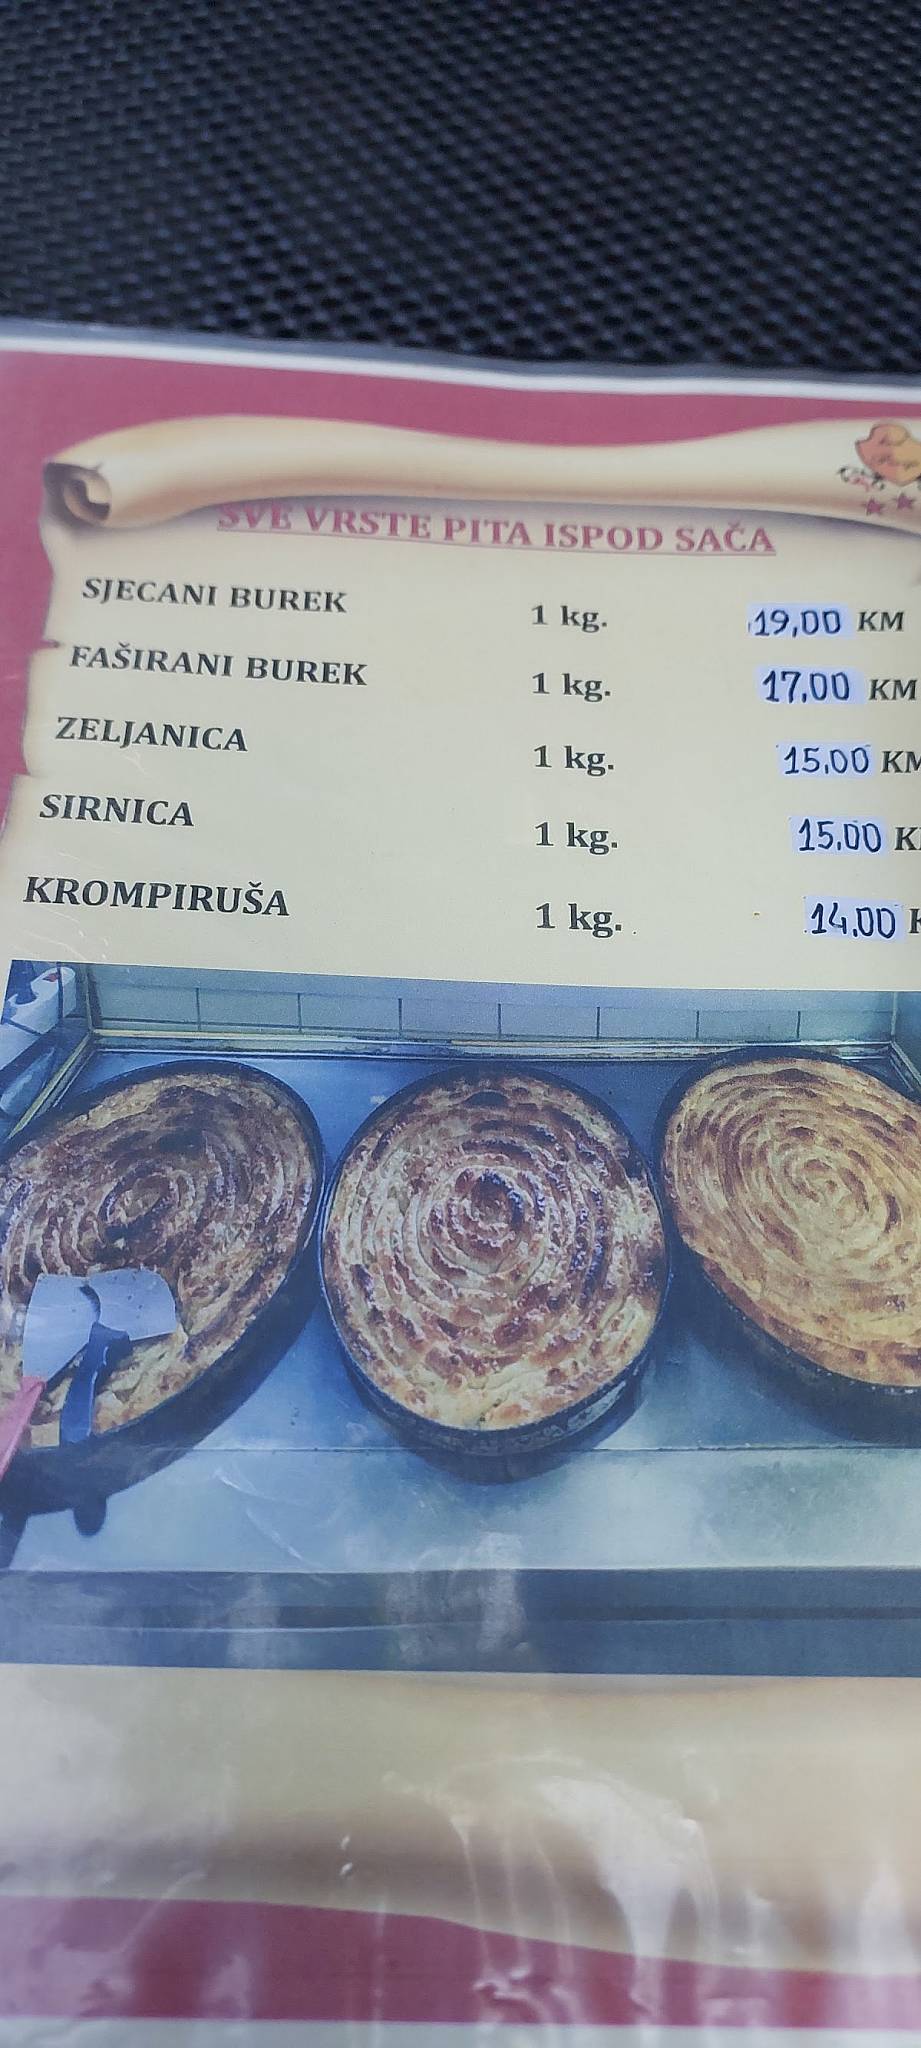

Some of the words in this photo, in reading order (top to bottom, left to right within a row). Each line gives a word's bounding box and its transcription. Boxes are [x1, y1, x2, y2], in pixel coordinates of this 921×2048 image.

[217, 499, 293, 531] SVE
[303, 506, 432, 540] VRSTE
[442, 516, 533, 546] PITA
[543, 520, 664, 551] ISPOD
[674, 519, 777, 553] SAČA
[82, 577, 217, 607] SJECANI
[230, 586, 347, 614] BUREK
[531, 604, 548, 625] 1
[560, 604, 608, 634] kg.
[754, 608, 842, 639] 19,00
[857, 610, 905, 632] KM
[69, 641, 234, 677] FAŠIRANI
[244, 656, 368, 686] BUREK
[532, 671, 551, 695] 1
[561, 672, 611, 703] kg.
[762, 669, 850, 704] 17,00
[868, 678, 918, 702] KM
[54, 716, 249, 752] ZELJANICA
[533, 744, 553, 769] 1
[563, 744, 615, 777] kg.
[38, 793, 195, 827] SIRNICA
[534, 821, 555, 847] 1
[565, 821, 618, 856] kg.
[893, 826, 921, 852] K
[22, 875, 291, 917] KROMPIRUŠA
[535, 902, 557, 930] 1
[567, 902, 623, 939] kg.
